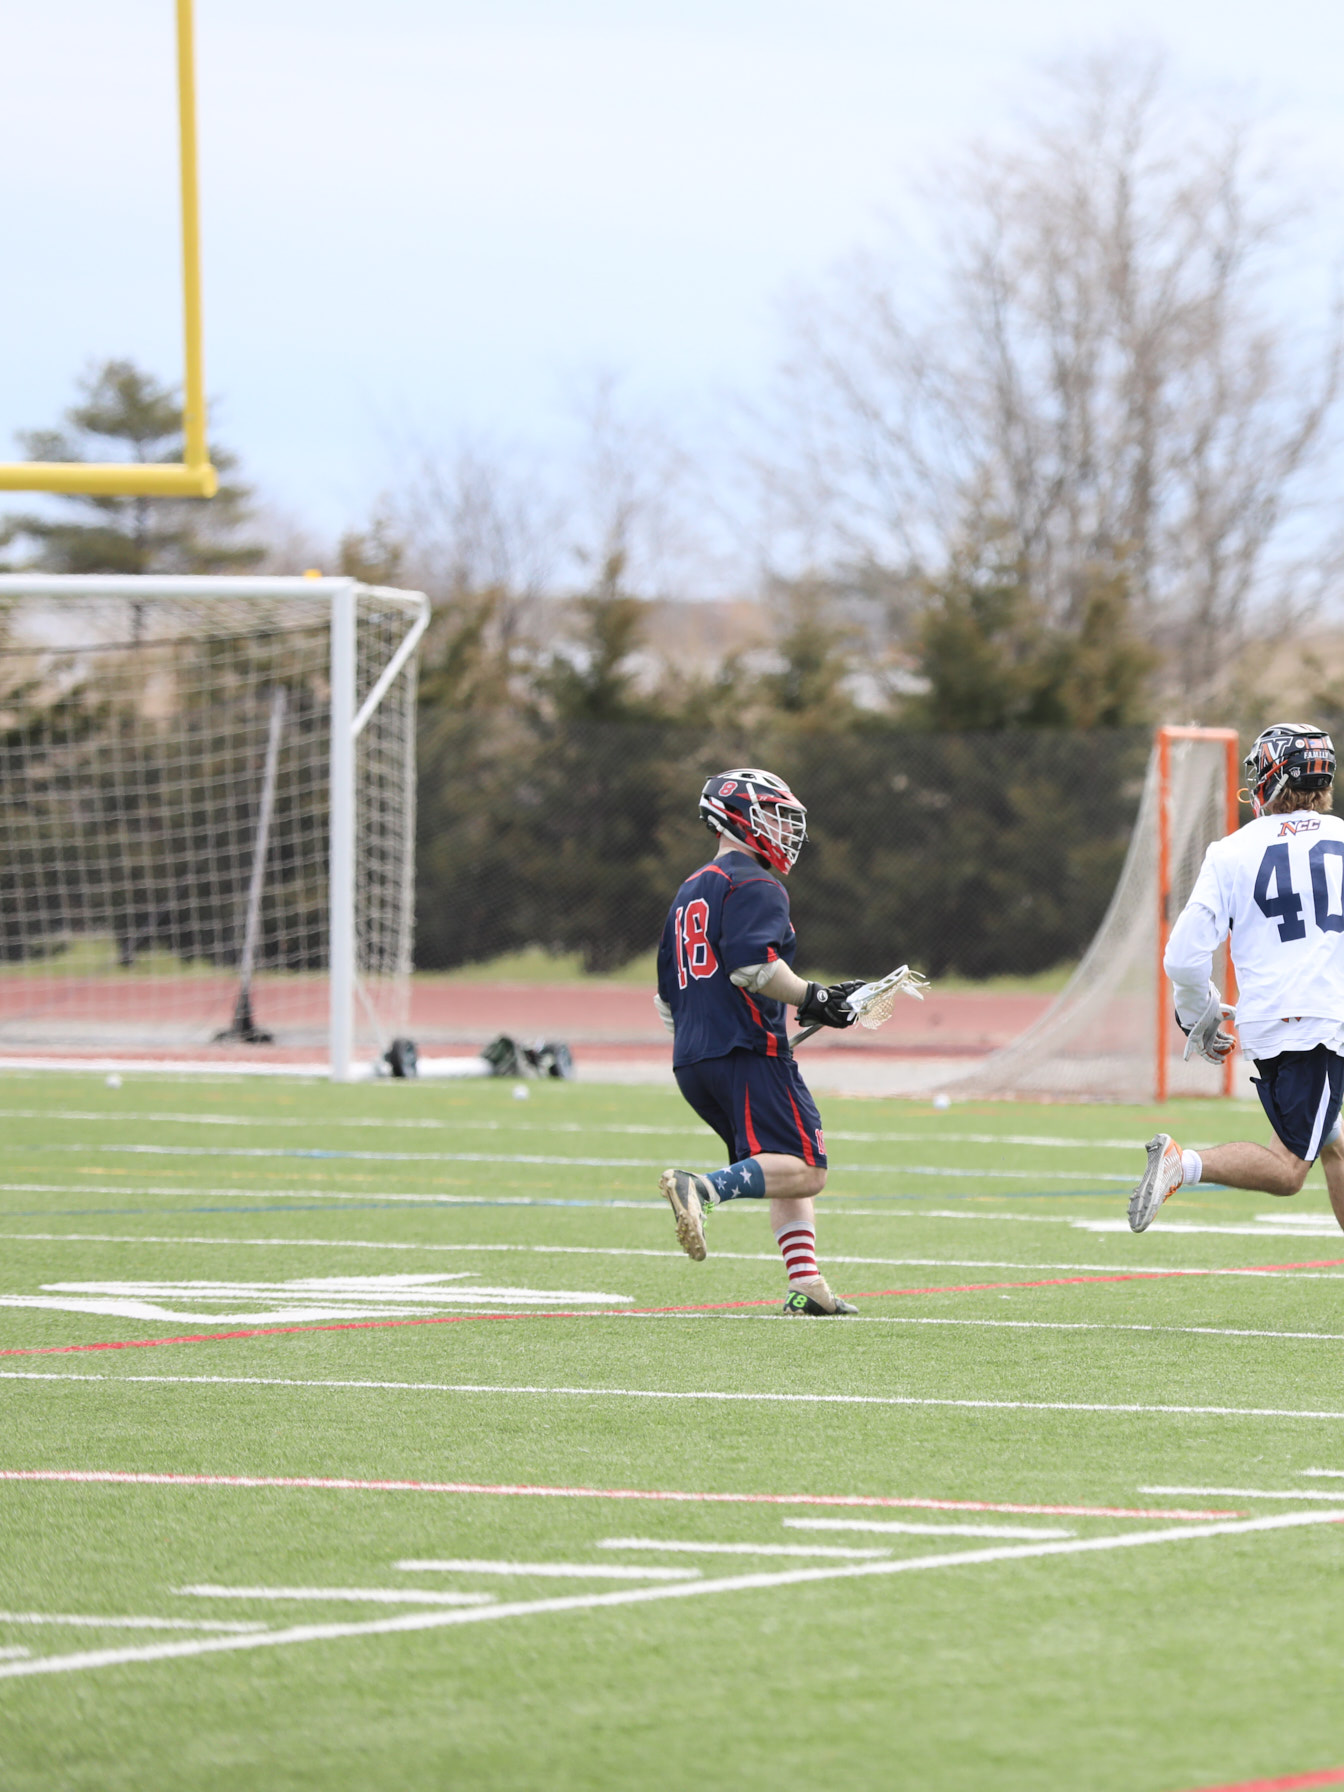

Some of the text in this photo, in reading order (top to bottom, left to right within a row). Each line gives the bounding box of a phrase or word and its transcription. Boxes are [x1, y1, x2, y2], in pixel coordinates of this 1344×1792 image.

[1277, 818, 1321, 837] NCC
[674, 898, 719, 990] 18
[786, 1291, 808, 1308] 18
